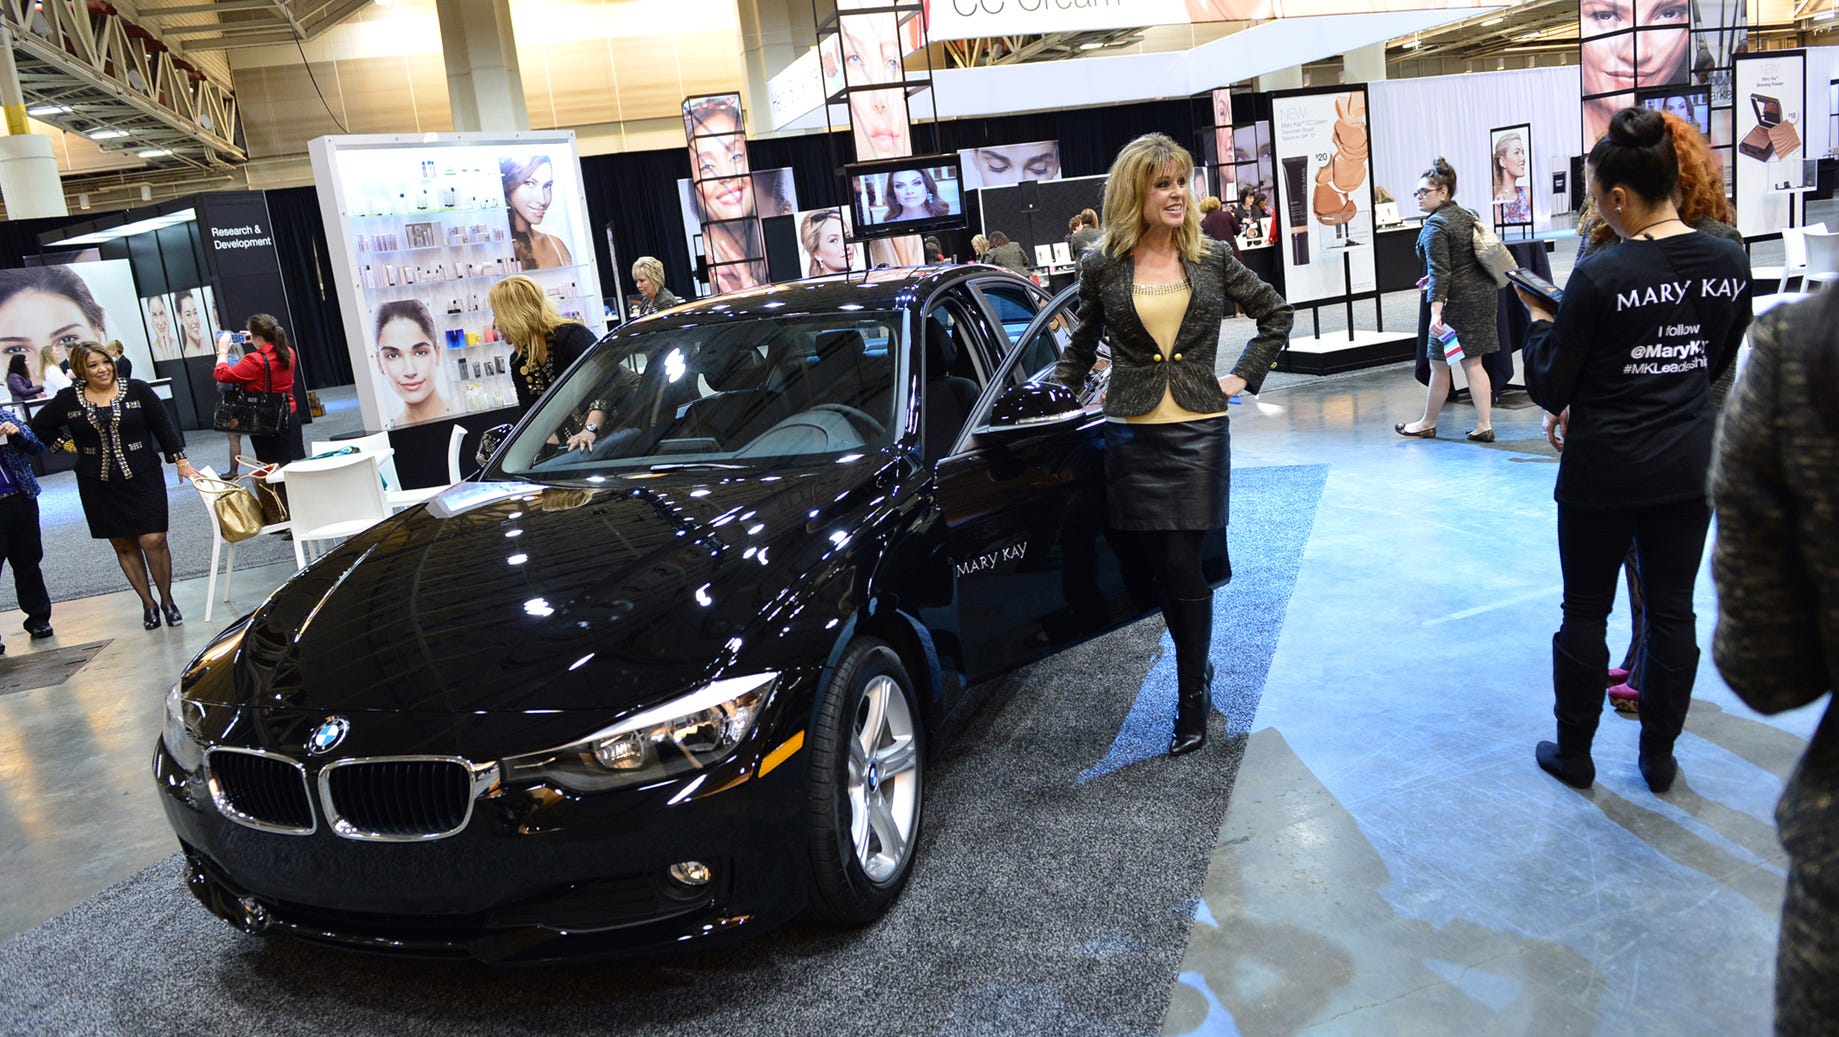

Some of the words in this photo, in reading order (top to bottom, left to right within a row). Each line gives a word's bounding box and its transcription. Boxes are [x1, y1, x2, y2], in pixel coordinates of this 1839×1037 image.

[1315, 152, 1328, 161] $20
[211, 225, 253, 237] Research
[254, 224, 262, 234] &
[214, 236, 272, 249] Development
[1616, 280, 1692, 312] MARY
[1701, 277, 1747, 302] KAY
[1658, 325, 1663, 338] I
[1664, 323, 1701, 337] follow
[956, 551, 998, 578] MARY
[1002, 541, 1028, 561] KAY
